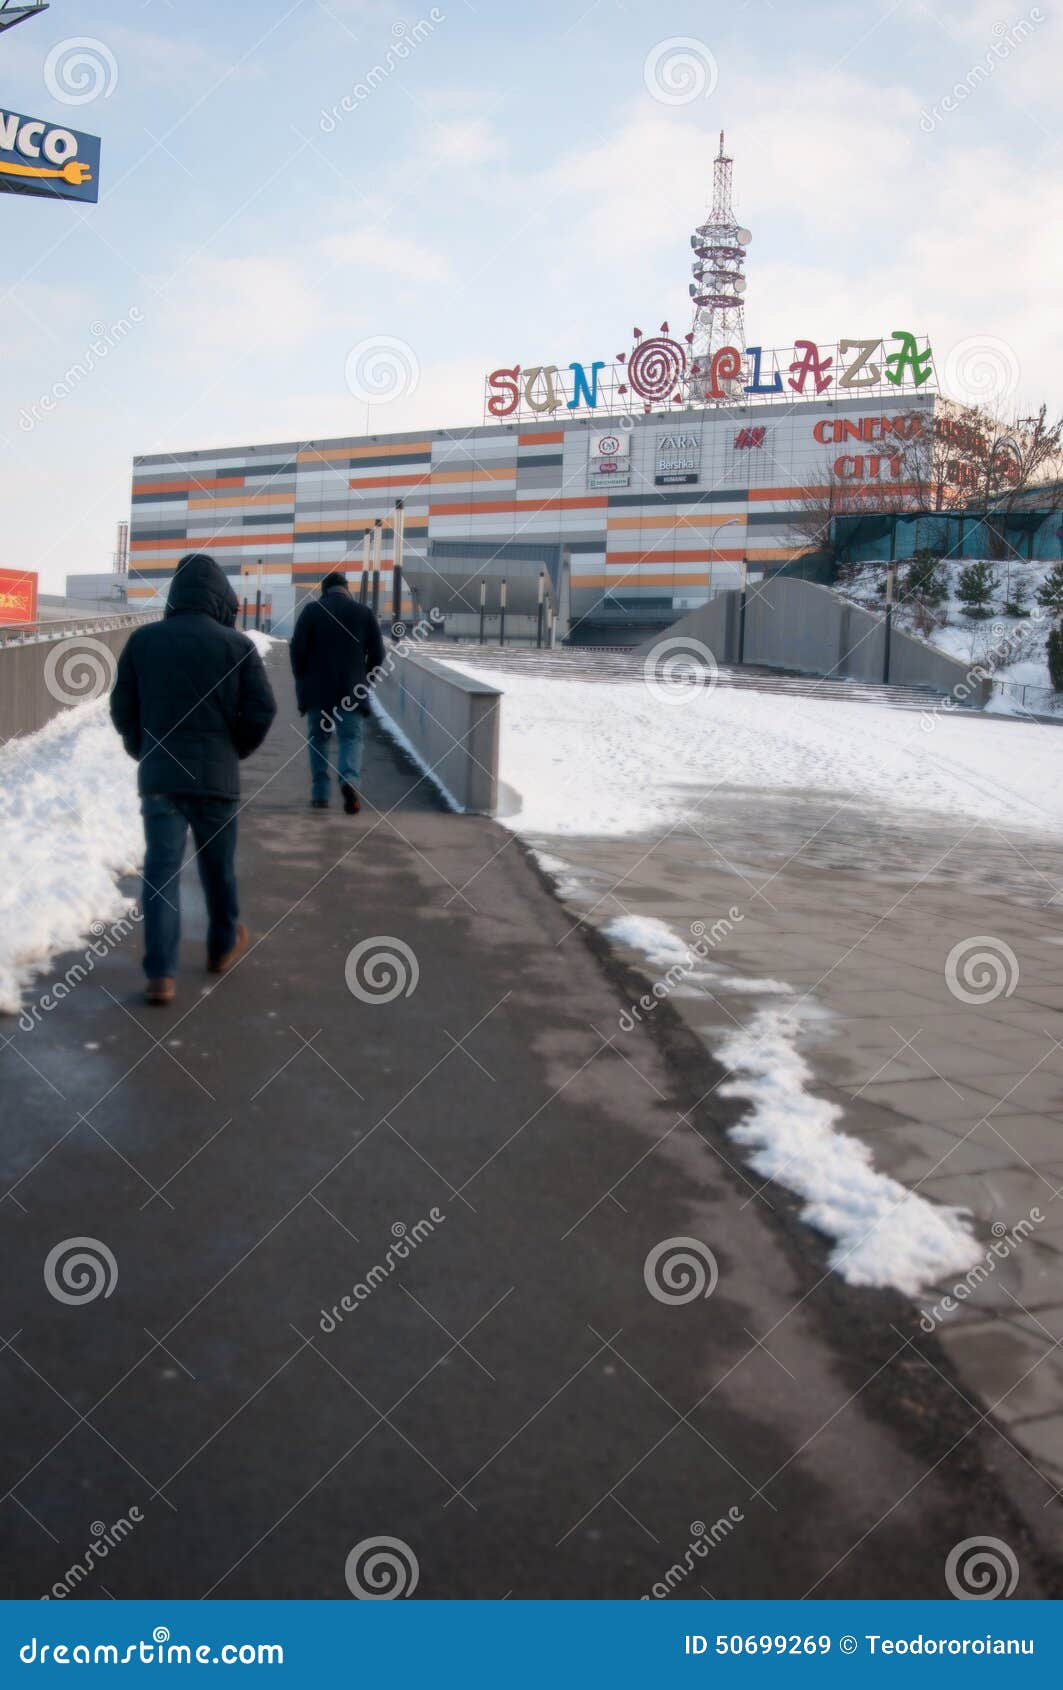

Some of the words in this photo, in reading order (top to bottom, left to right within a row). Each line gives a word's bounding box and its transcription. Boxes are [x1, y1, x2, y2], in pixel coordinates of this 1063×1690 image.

[487, 361, 606, 417] SUN
[705, 331, 932, 399] PLAZA
[657, 436, 699, 450] ZARA
[659, 458, 694, 471] Bershka
[834, 452, 904, 480] CITY
